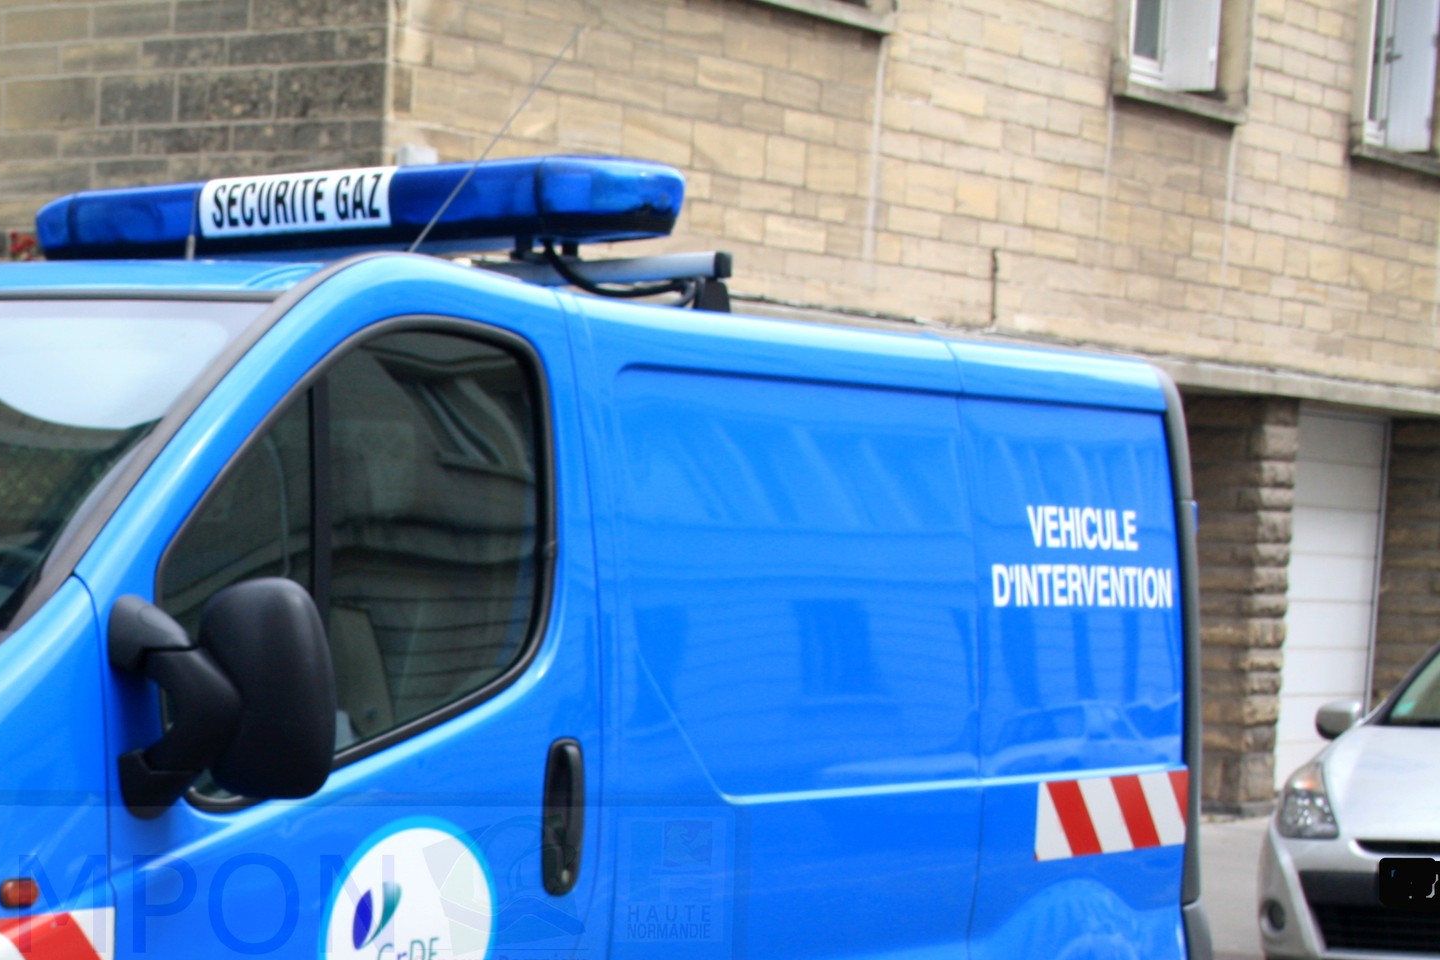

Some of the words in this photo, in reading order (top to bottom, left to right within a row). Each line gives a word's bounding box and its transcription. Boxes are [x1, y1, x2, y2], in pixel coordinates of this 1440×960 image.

[212, 177, 328, 229] SECURITE
[335, 173, 383, 221] GAZ
[1026, 505, 1139, 551] VEHICULE
[991, 564, 1173, 608] D'INTERVENTION
